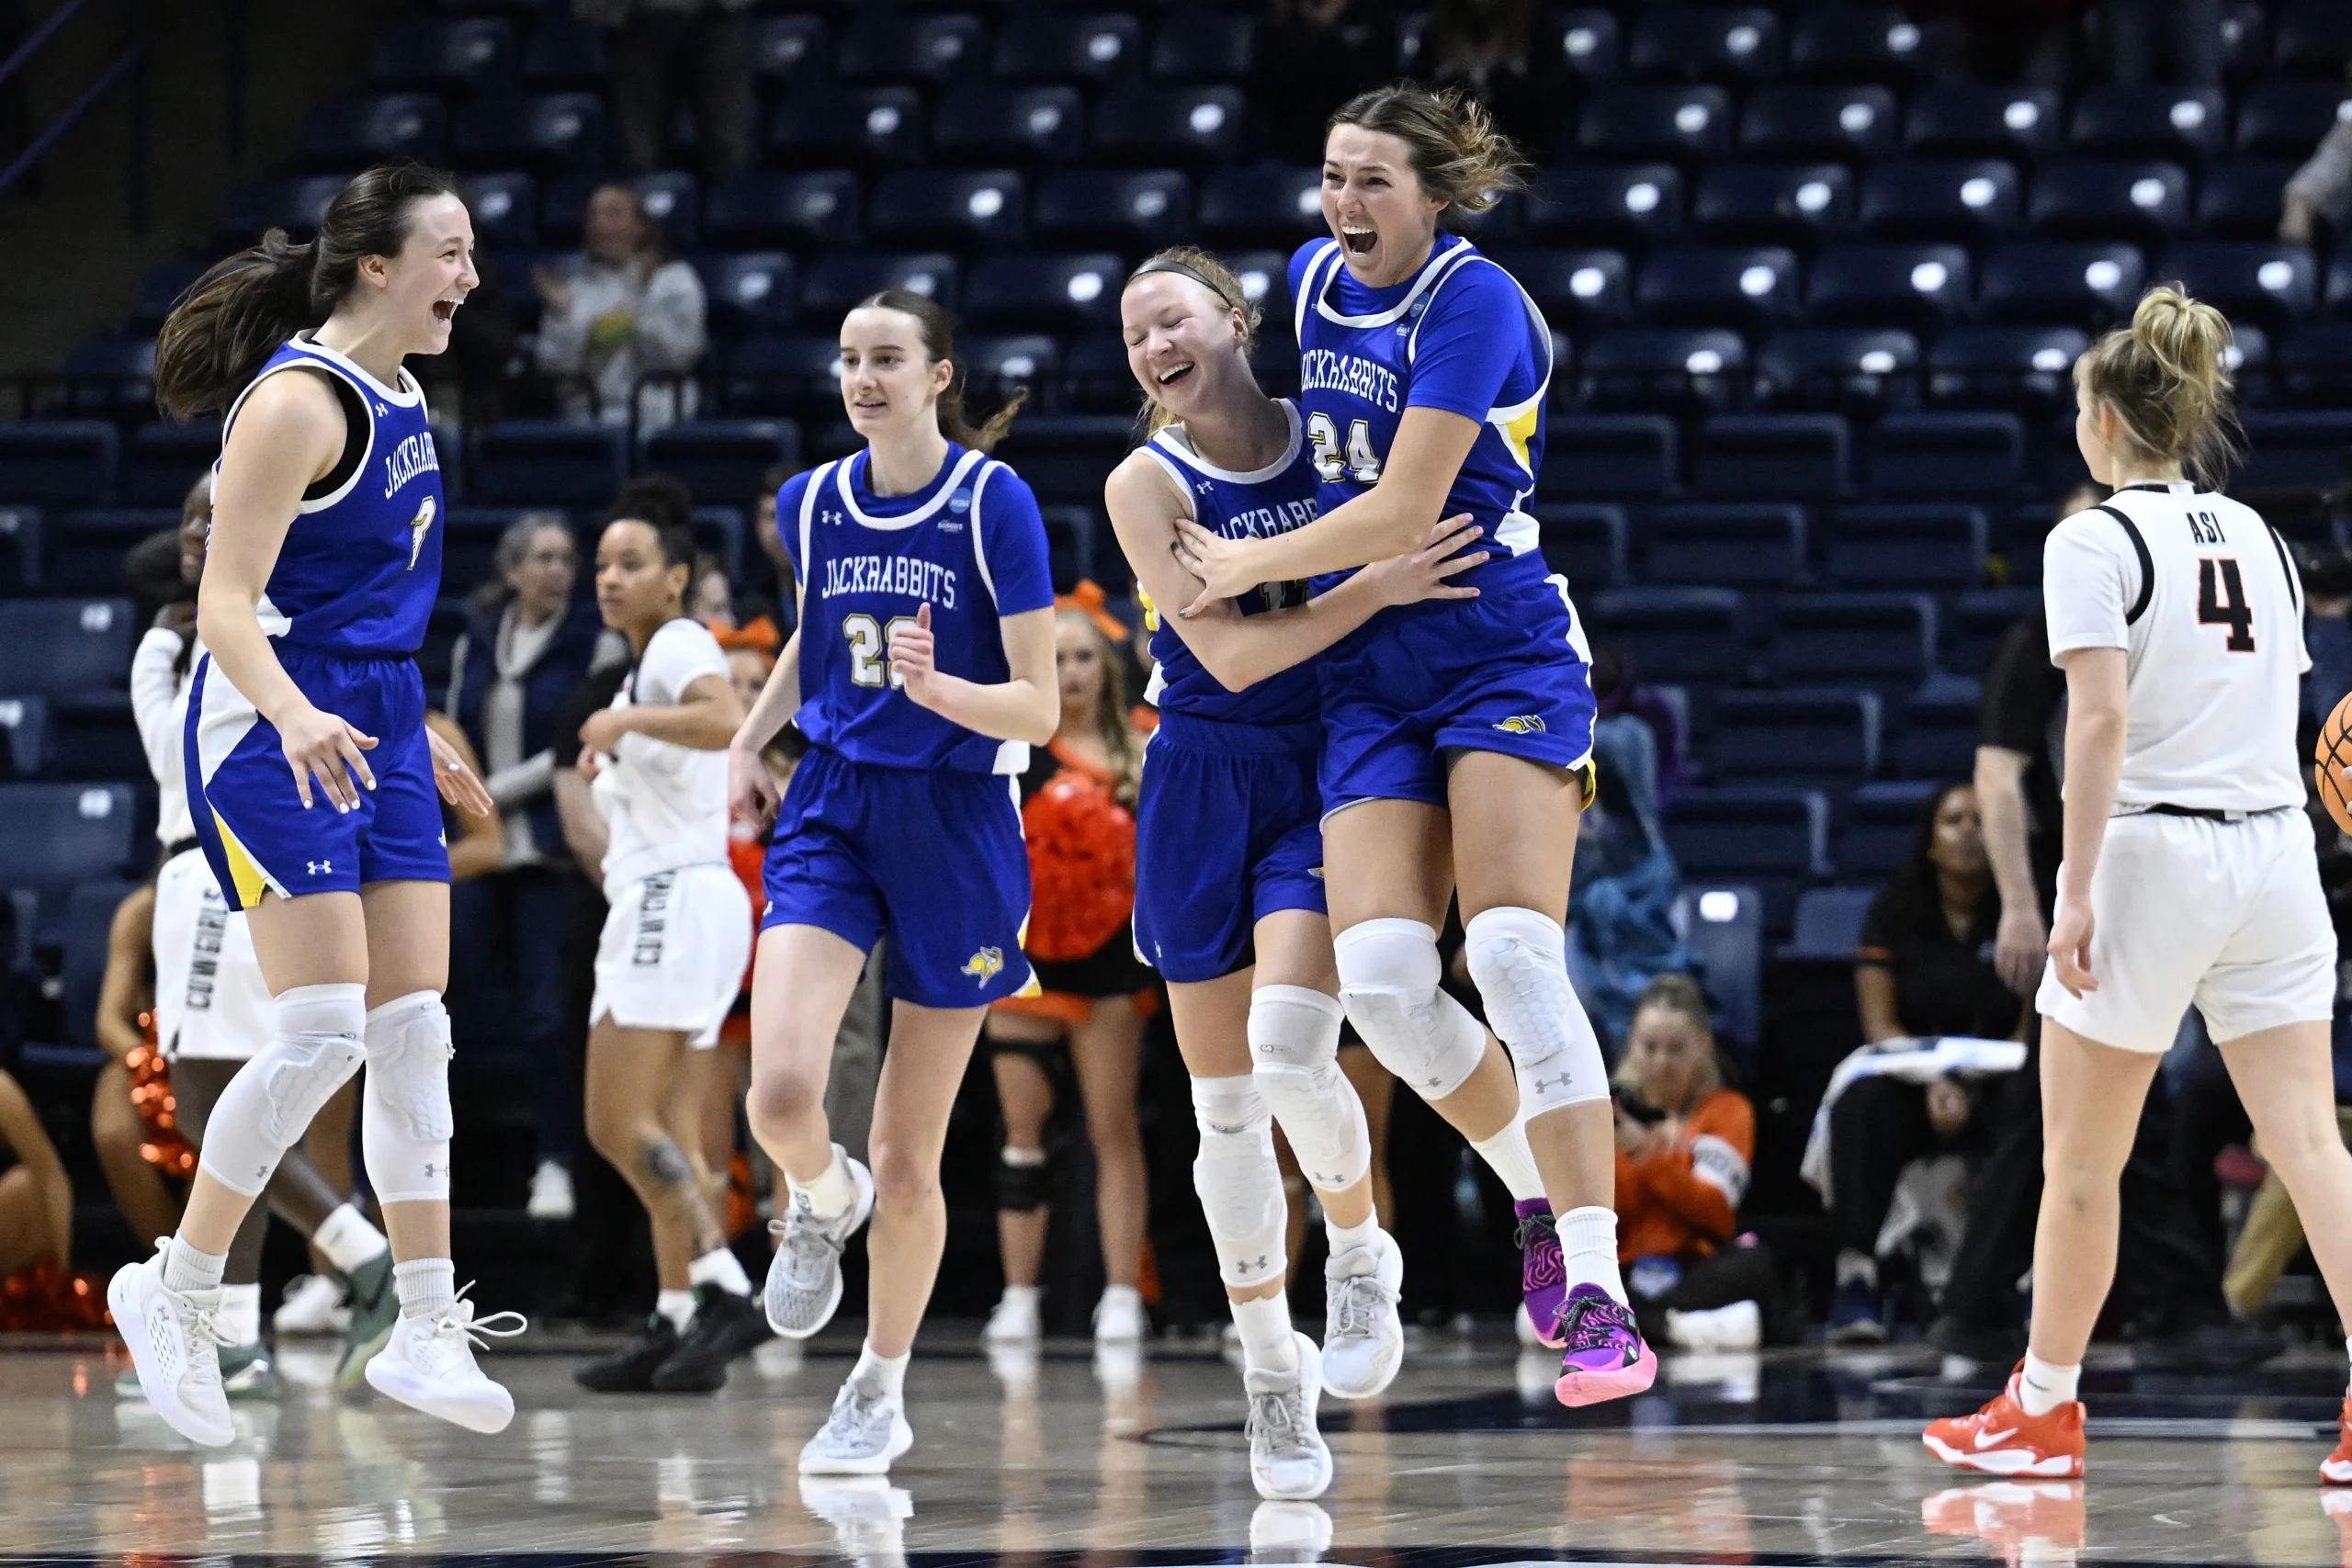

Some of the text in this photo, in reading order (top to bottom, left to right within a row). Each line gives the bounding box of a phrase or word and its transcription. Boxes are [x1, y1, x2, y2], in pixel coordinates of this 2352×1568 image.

[1307, 412, 1382, 484] 24
[2185, 512, 2226, 544] ASI
[822, 556, 956, 610] JACKRABBITS
[2198, 558, 2256, 653] 4
